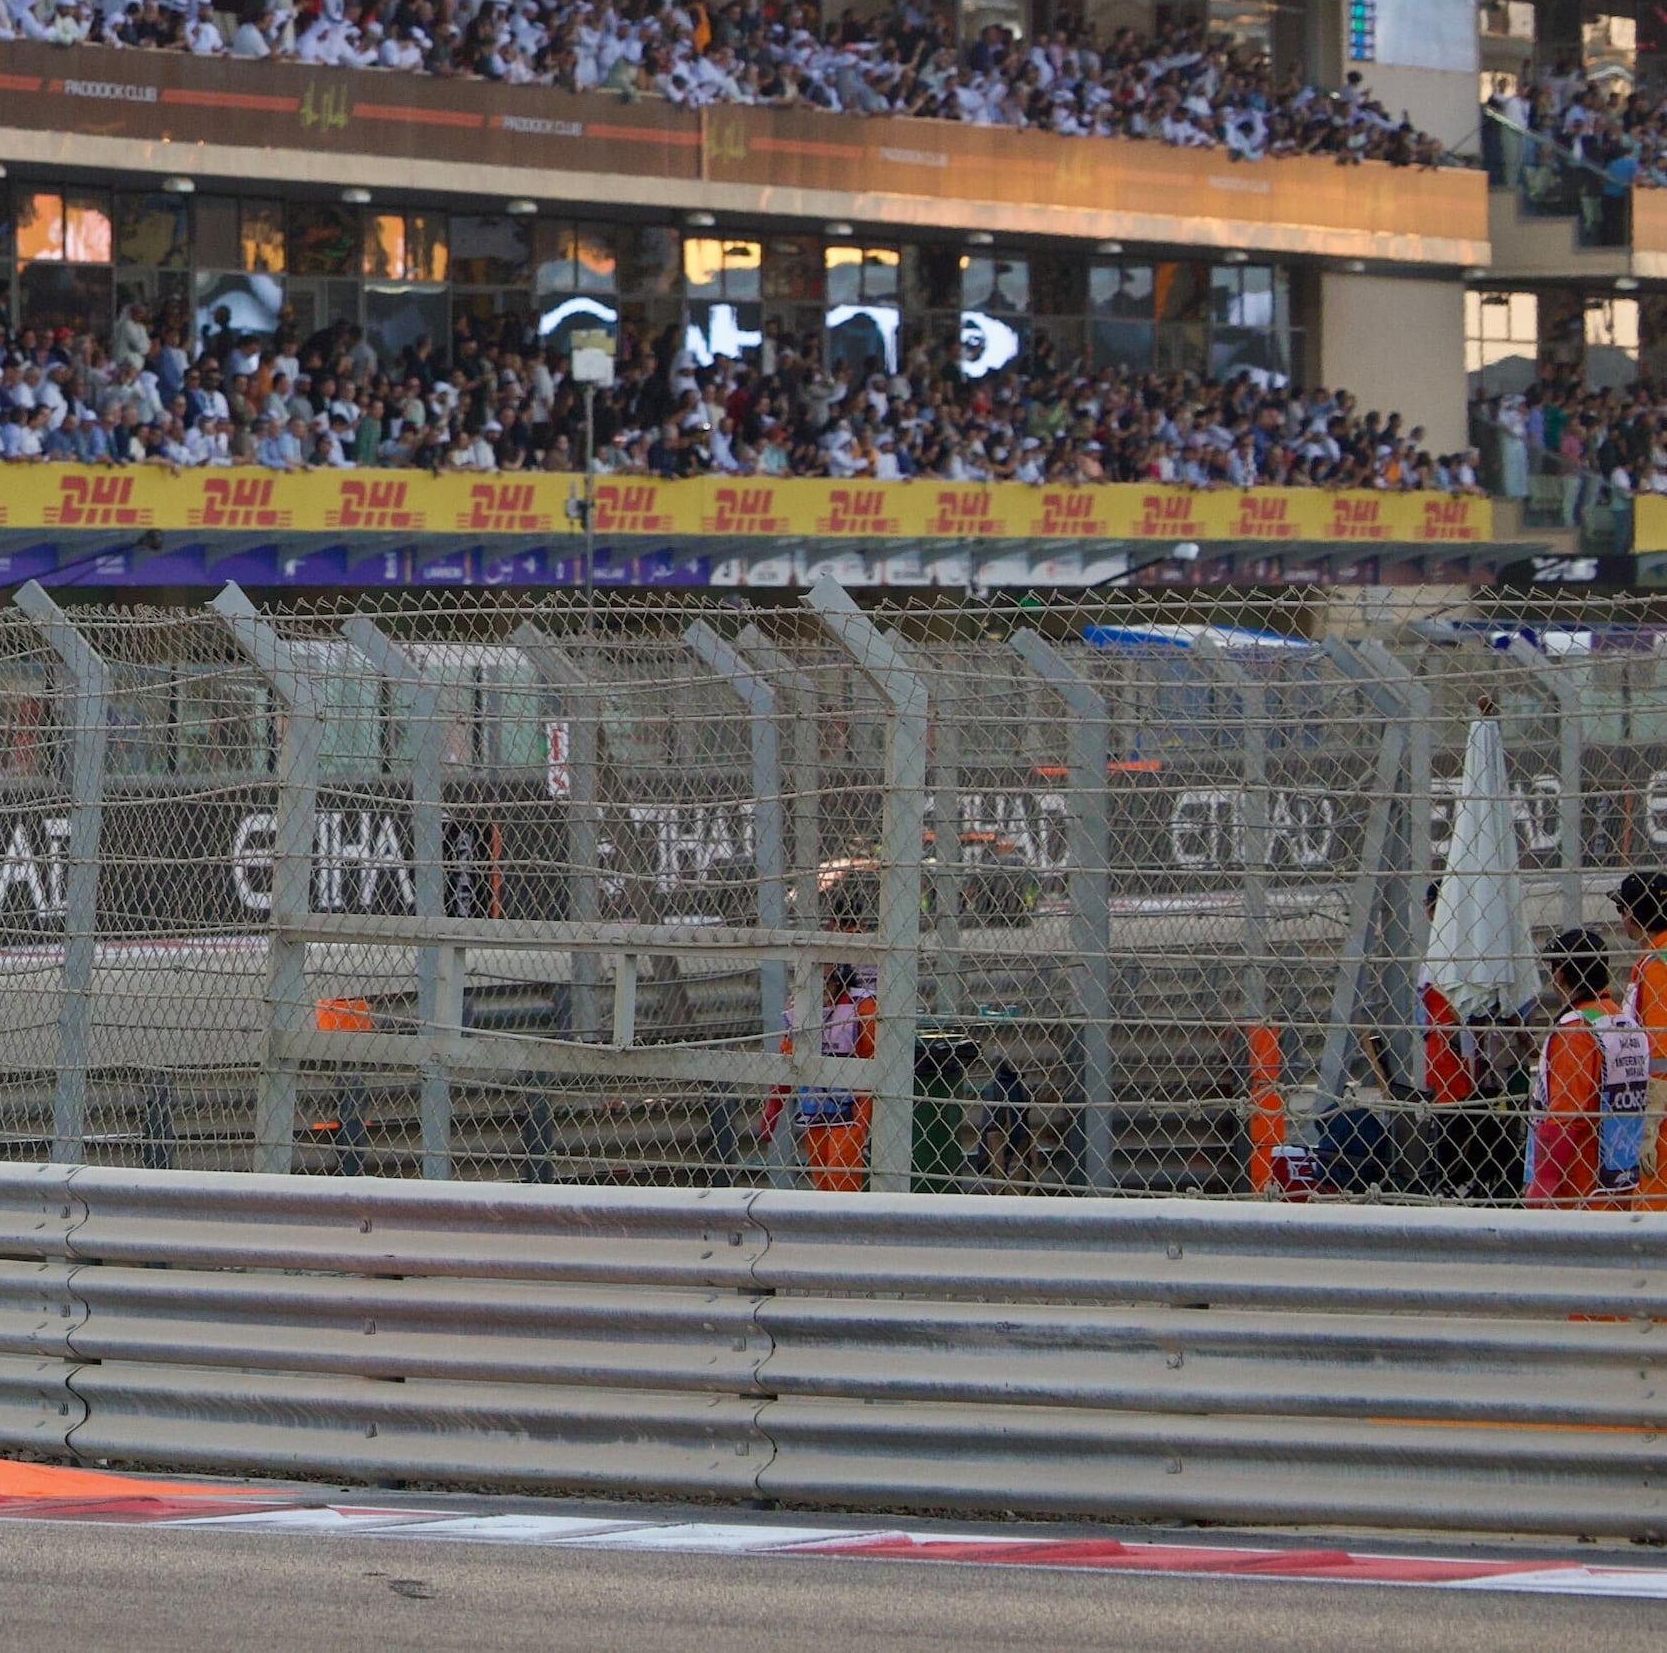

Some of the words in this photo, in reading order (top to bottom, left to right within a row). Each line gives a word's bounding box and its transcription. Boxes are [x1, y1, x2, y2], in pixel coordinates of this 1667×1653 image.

[59, 475, 138, 524] DHL
[203, 477, 278, 526] DHL
[339, 480, 411, 528] DHL
[470, 483, 539, 529] DHL
[594, 485, 661, 530] DHL
[714, 488, 777, 532] DHL
[829, 490, 888, 533] DHL
[937, 491, 995, 534] DHL
[1041, 493, 1098, 535] DHL
[1141, 496, 1196, 536] DHL
[1239, 497, 1291, 537] DHL
[1332, 498, 1383, 538] DHL
